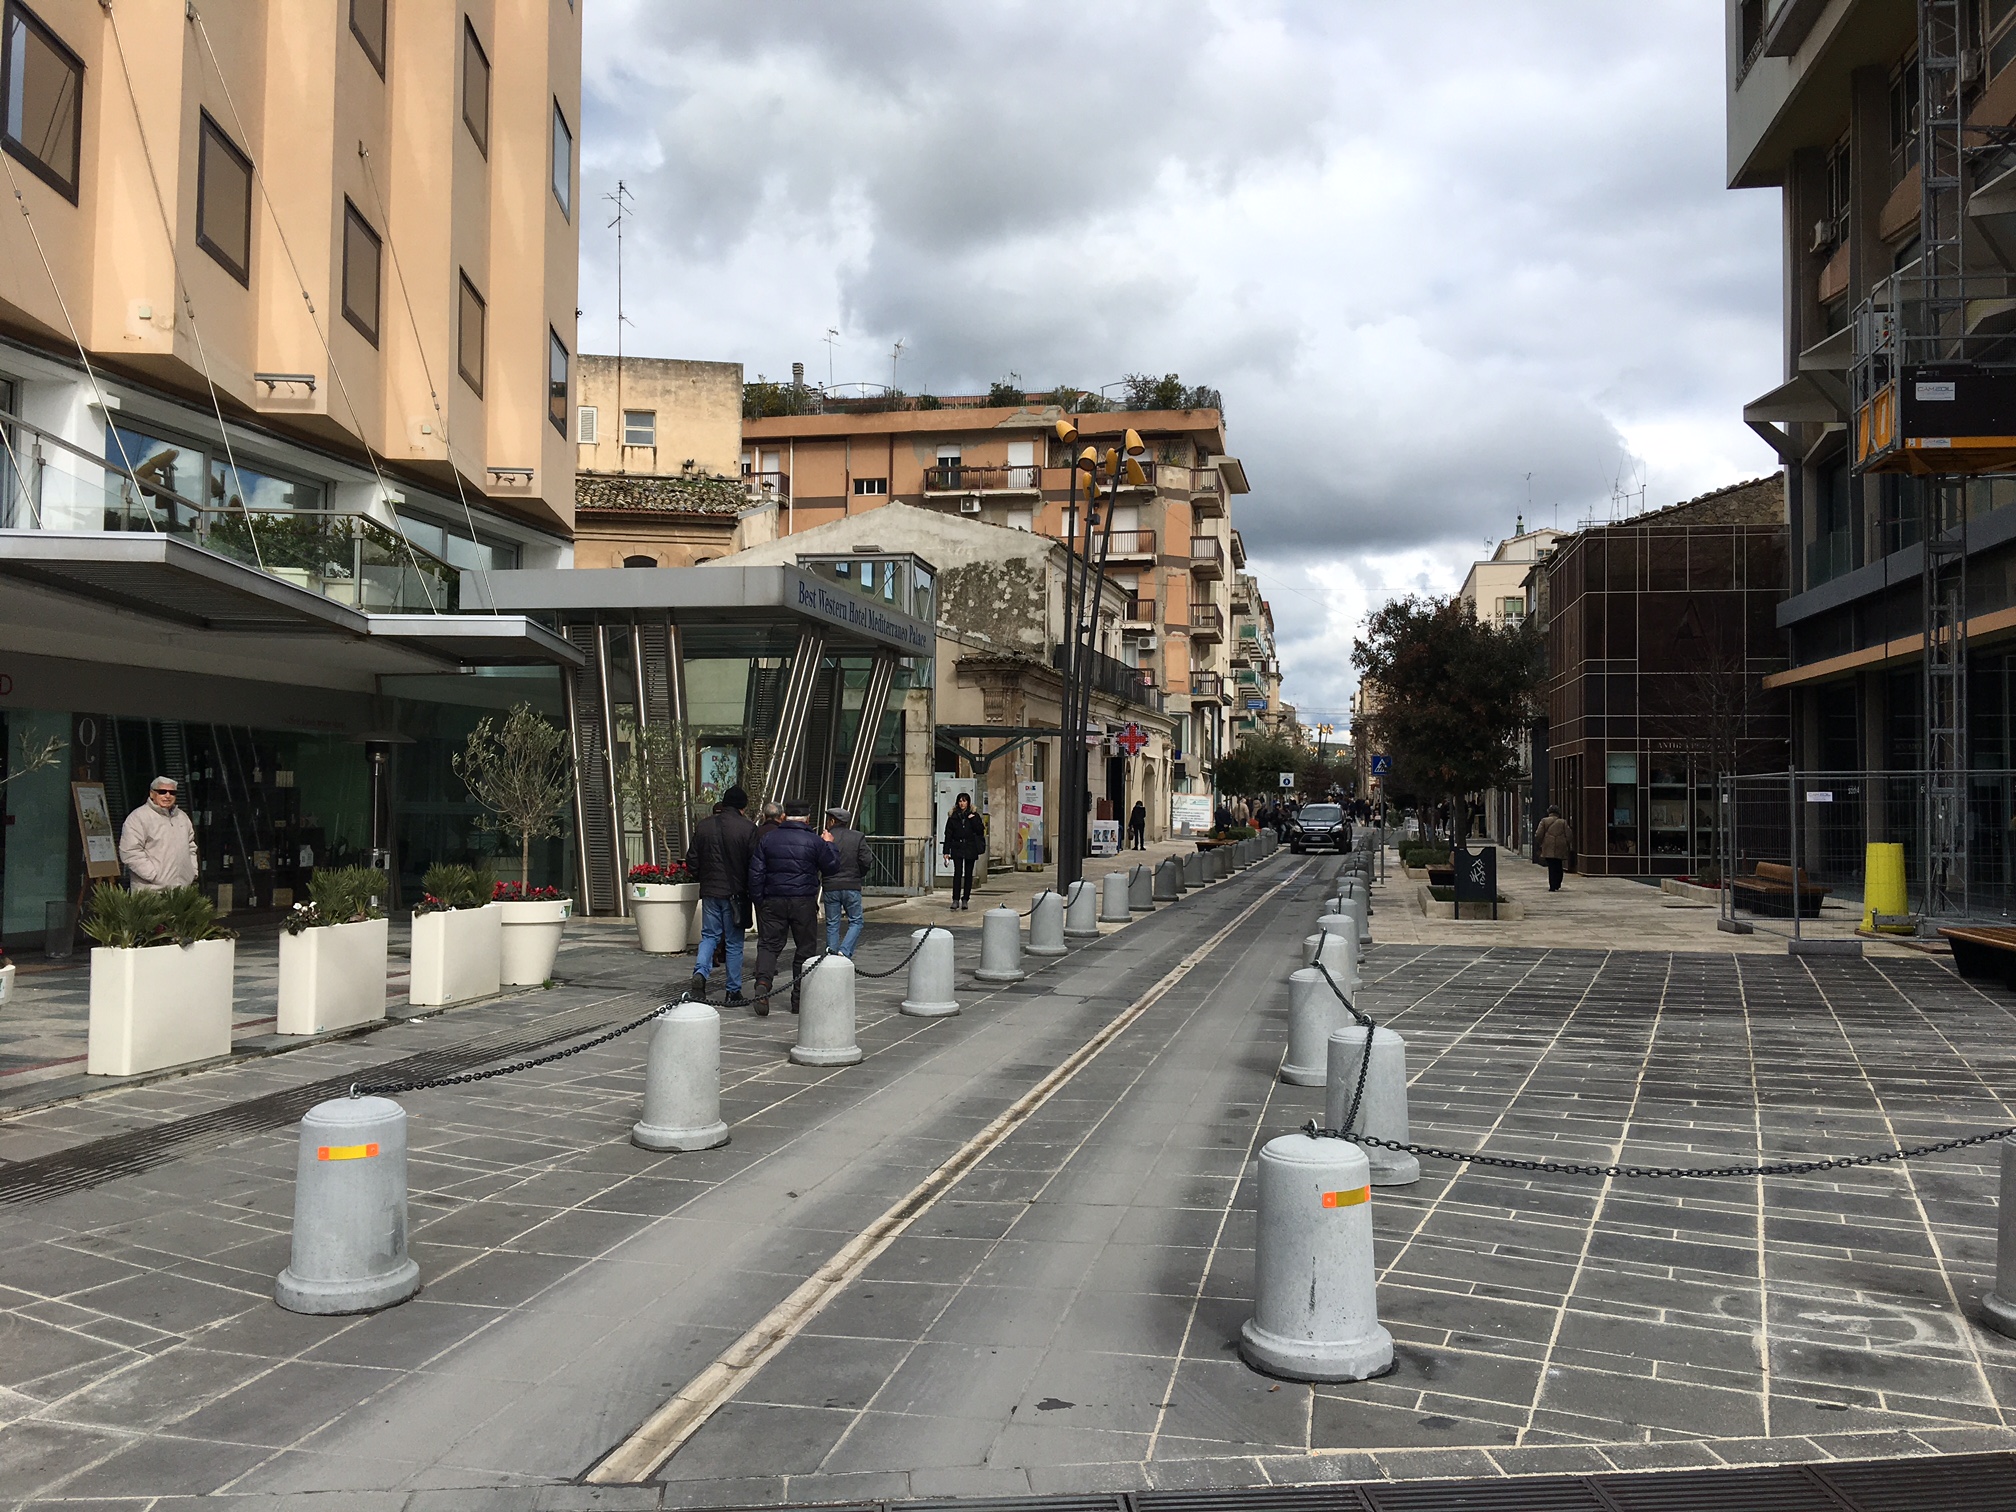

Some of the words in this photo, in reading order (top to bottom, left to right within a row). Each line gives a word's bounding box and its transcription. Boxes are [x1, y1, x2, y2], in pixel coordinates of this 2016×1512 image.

[798, 580, 816, 609] Best
[818, 589, 847, 620] Western
[849, 601, 867, 628] Hotel
[868, 609, 908, 642] Mediterraneo
[909, 624, 927, 648] Palace
